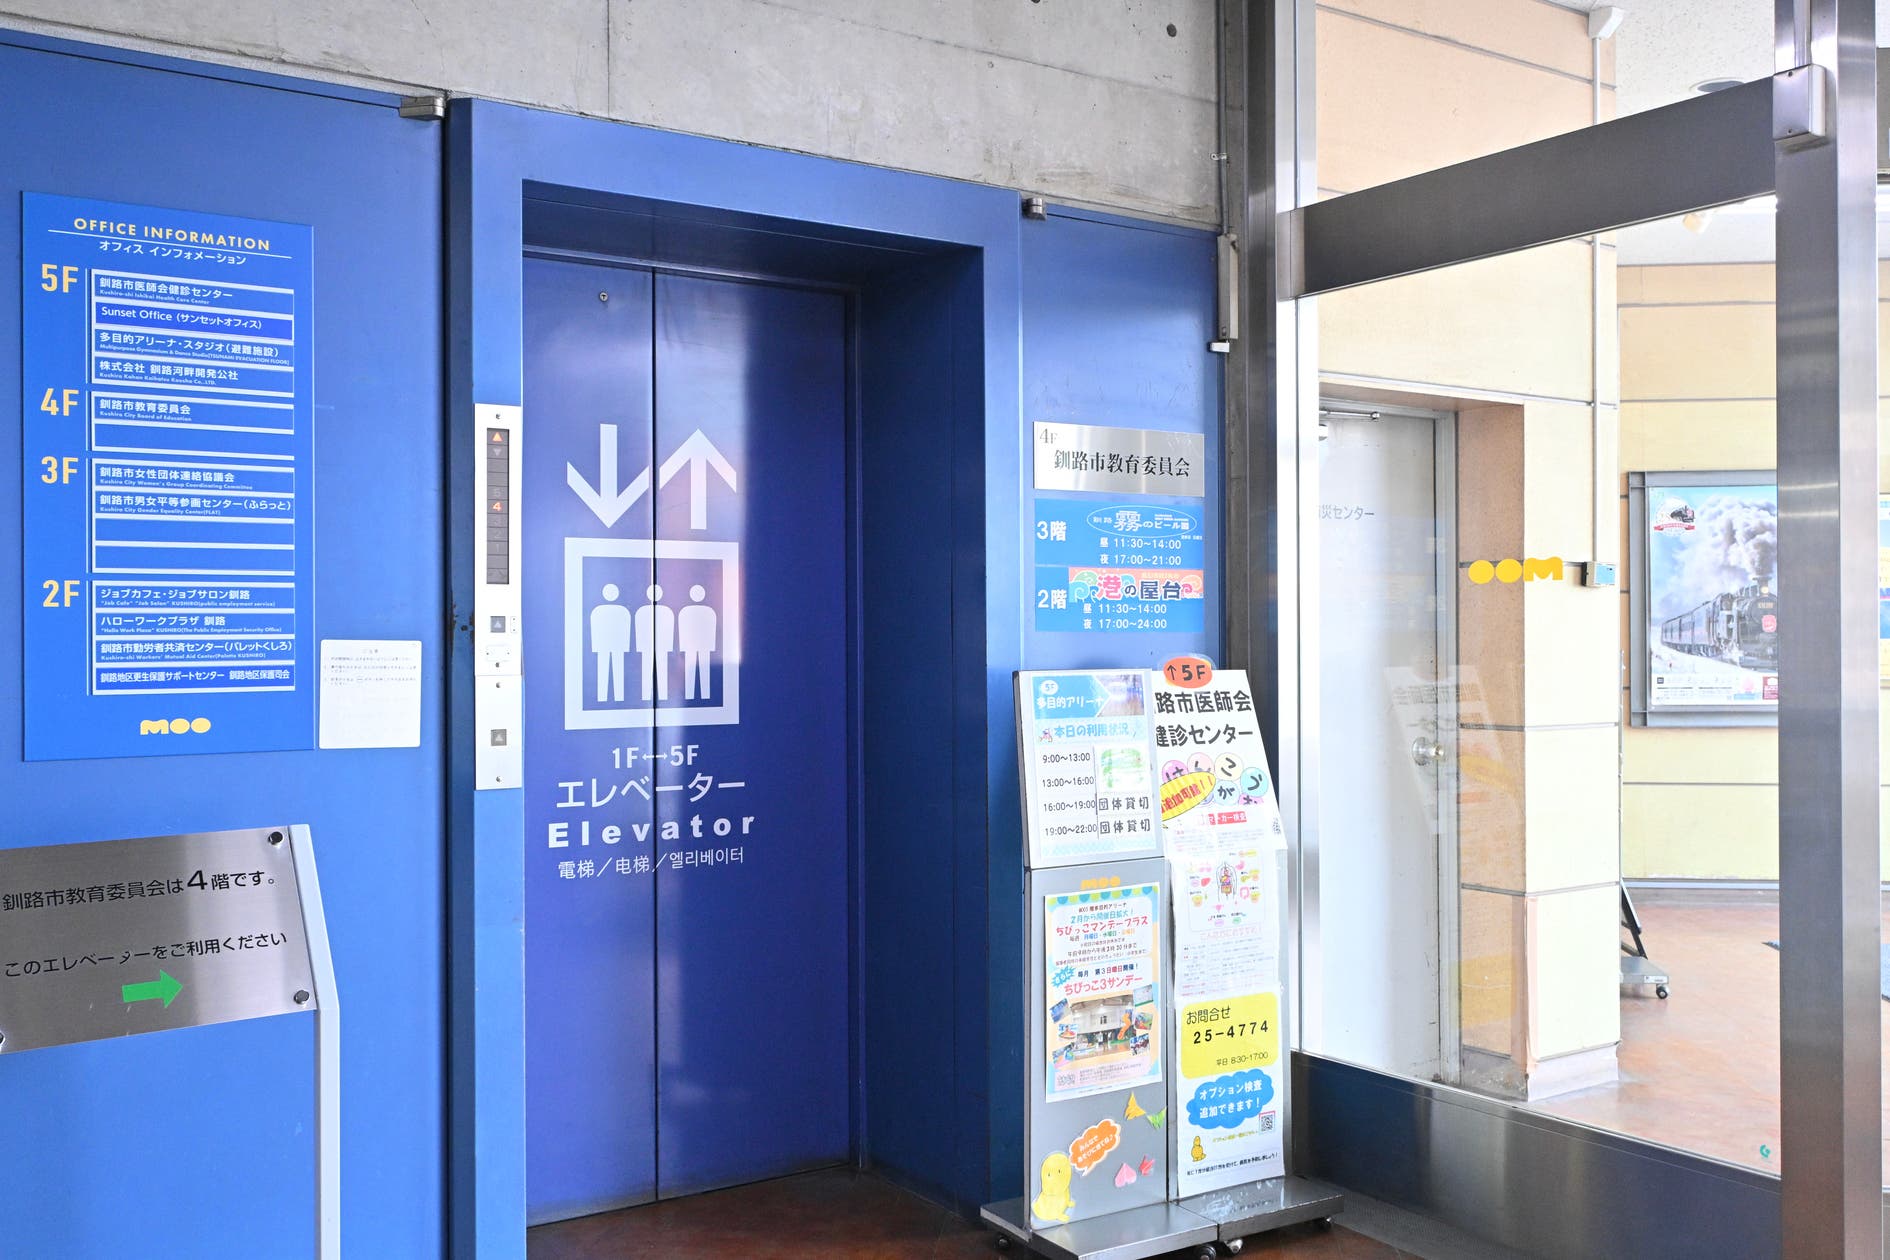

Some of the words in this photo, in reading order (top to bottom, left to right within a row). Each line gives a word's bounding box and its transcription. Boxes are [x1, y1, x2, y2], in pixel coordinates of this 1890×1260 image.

[74, 217, 137, 236] OFFICE
[144, 226, 270, 251] INFORMATION
[100, 240, 144, 255] オフィス
[150, 247, 246, 265] インフォメーション
[41, 263, 78, 293] 5F
[100, 278, 232, 298] 釧路市医師会健診センター
[101, 306, 136, 318] Sunset
[140, 309, 173, 322] Office
[100, 360, 145, 373] 株式会社
[40, 388, 78, 416] 4F
[100, 398, 190, 415] 釧路市教育委員会
[1039, 428, 1057, 444] 4F
[40, 456, 78, 484] 3F
[100, 466, 235, 482] 釧路市女性団体連絡協議会
[1054, 450, 1190, 477] 釧路市教育委員会
[492, 502, 501, 511] 4
[1318, 504, 1375, 520] 災センター
[1036, 520, 1067, 542] 3階
[1100, 555, 1109, 565] 夜
[42, 580, 80, 608] 2F
[101, 589, 250, 600] ジョブカフェ・ジョブサロン釧路
[1096, 575, 1181, 600] 港の屋台
[1037, 589, 1067, 610] 2階
[101, 615, 199, 626] ハローワークプラザ
[204, 616, 225, 626] 釧路
[1084, 619, 1092, 629] 夜
[1182, 664, 1206, 681] 5F
[1154, 690, 1252, 714] 路市医師会
[140, 717, 211, 735] MOO
[612, 747, 639, 769] 1F
[670, 744, 699, 767] 5F
[556, 772, 745, 808] エレベーター
[548, 814, 755, 848] Elevator
[2, 870, 276, 911] 釧路市教育委員会は4階です。
[1080, 876, 1121, 891] MOO
[1186, 1005, 1231, 1025] お問合せ
[1193, 1020, 1269, 1044] 25-4774
[1216, 1058, 1228, 1066] 平日
[1200, 1079, 1262, 1101] オプション検査
[1200, 1097, 1260, 1119] 追加できます！
